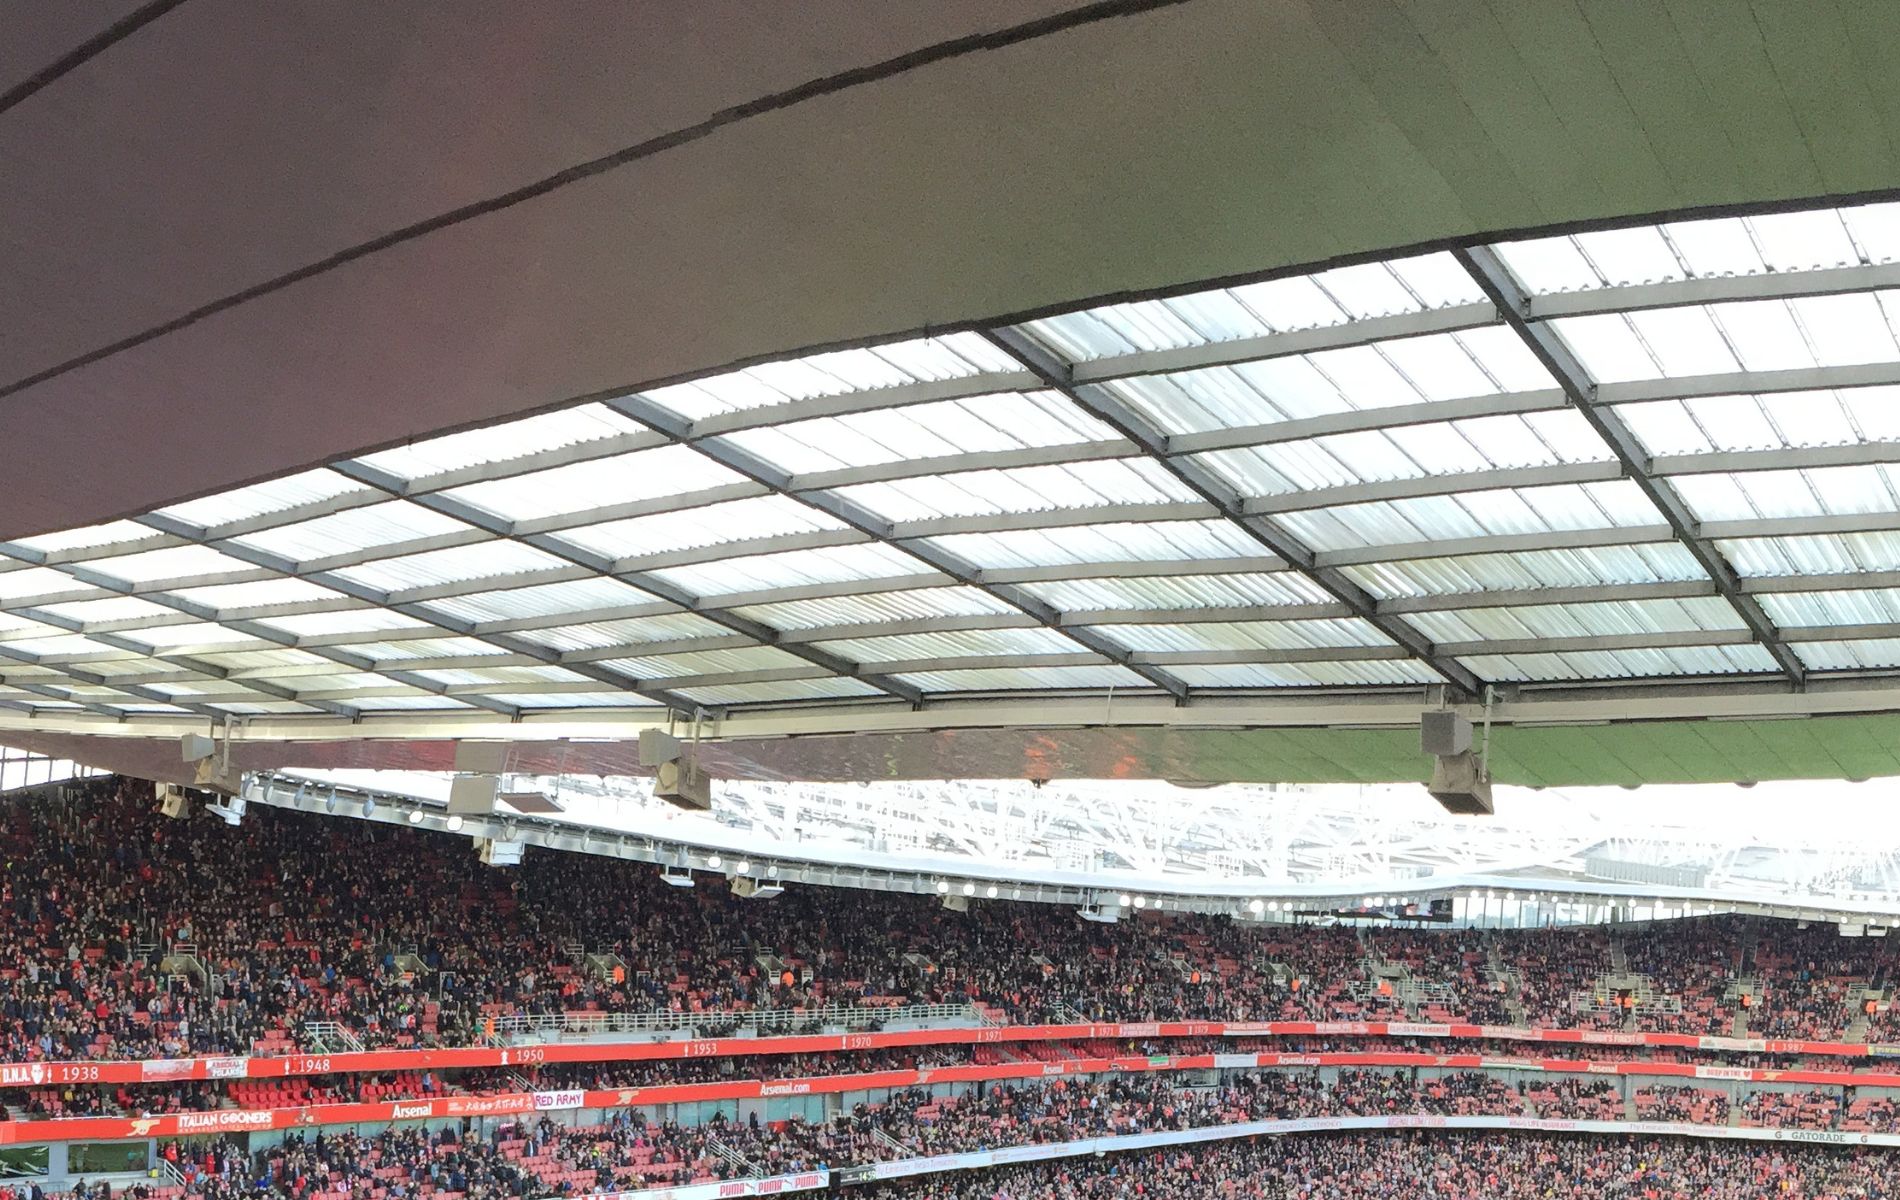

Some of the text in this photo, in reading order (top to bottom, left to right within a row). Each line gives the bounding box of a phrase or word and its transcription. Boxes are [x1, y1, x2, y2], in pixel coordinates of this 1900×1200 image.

[851, 1036, 872, 1048] 1970
[1783, 1043, 1805, 1051] 1987
[516, 1049, 544, 1062] 1950
[694, 1043, 717, 1055] 1953
[300, 1059, 330, 1073] 1948
[1277, 1055, 1321, 1066] Arsenal.com
[62, 1066, 99, 1081] 1938
[1587, 1063, 1618, 1073] Arsenal
[760, 1082, 810, 1096] Arsenal.com
[535, 1095, 553, 1106] RED
[556, 1093, 582, 1106] ARMY
[392, 1102, 432, 1119] Arsenal
[179, 1111, 273, 1128] ITALIAN GOONERS
[1774, 1131, 1869, 1144] G GATORADE G
[720, 1176, 819, 1197] PUMA PUMA PUMA
